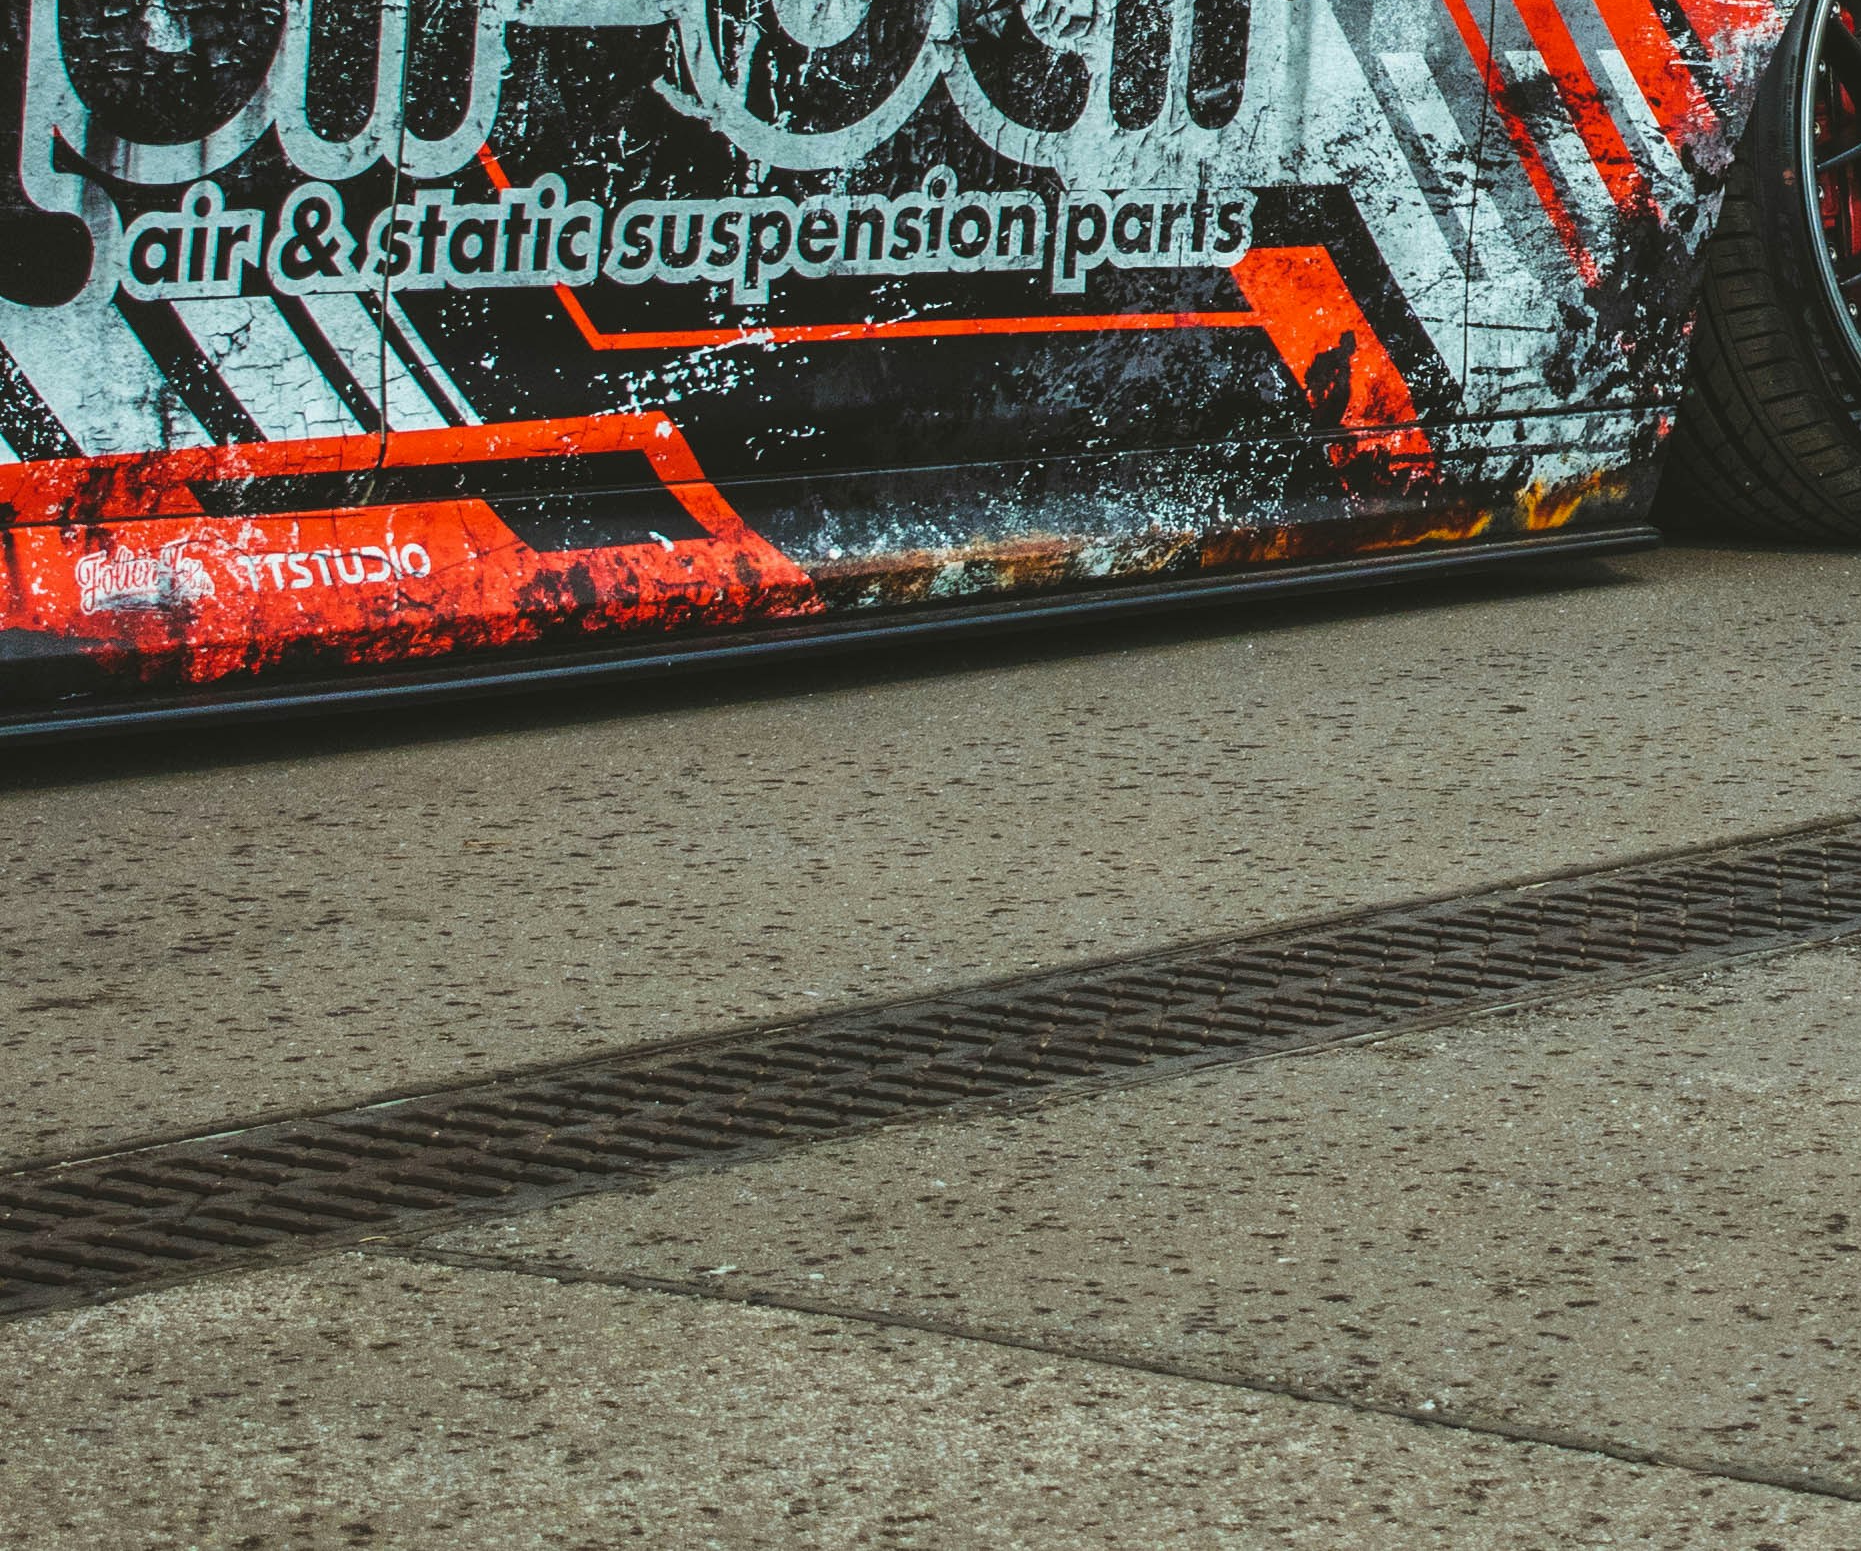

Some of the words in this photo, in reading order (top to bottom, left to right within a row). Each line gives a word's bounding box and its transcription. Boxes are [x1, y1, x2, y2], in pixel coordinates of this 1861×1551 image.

[127, 193, 252, 286] air
[279, 194, 345, 279] &
[372, 182, 595, 276] static
[616, 175, 1042, 291] suspension
[1062, 186, 1248, 280] parts
